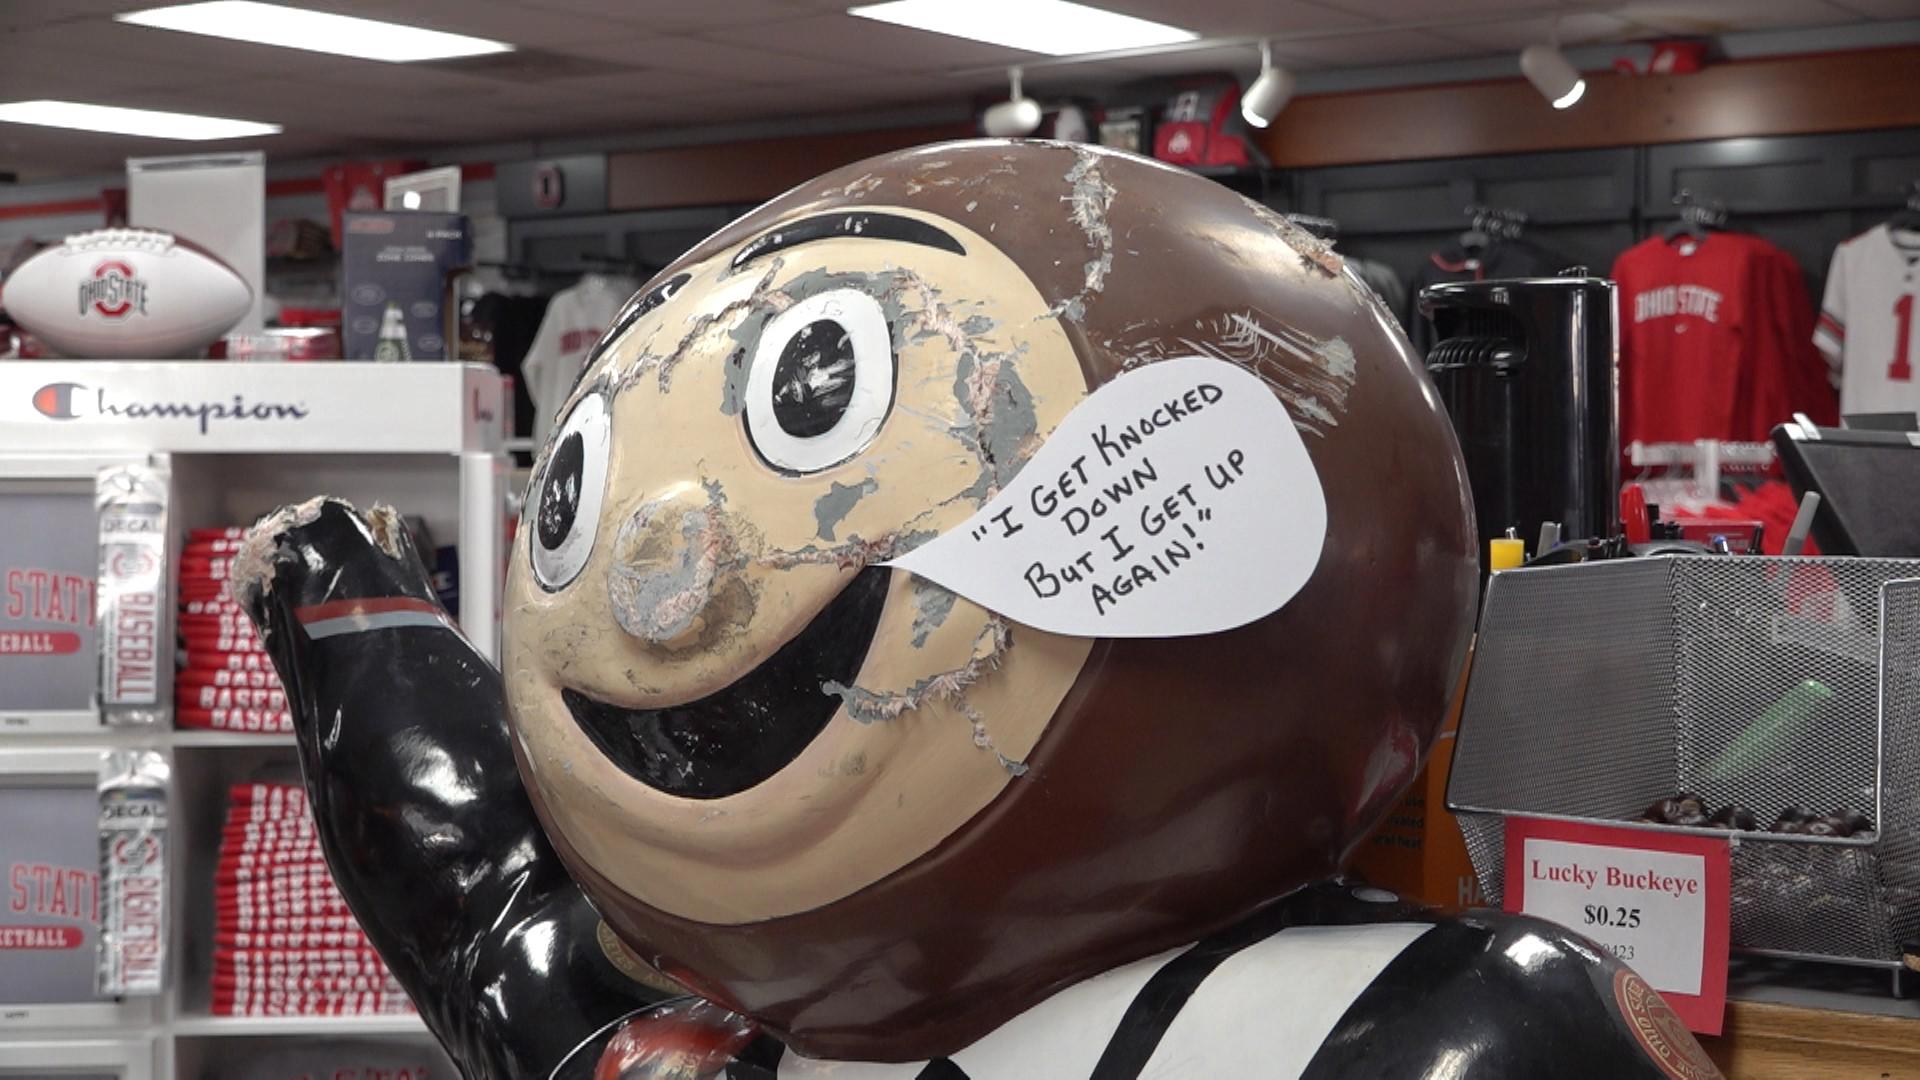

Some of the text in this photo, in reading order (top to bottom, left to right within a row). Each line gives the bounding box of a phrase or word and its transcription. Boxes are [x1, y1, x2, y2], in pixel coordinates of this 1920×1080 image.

[1634, 284, 1724, 323] OHIO STATE
[33, 382, 308, 434] Champion
[1031, 455, 1089, 517] GET
[1092, 384, 1223, 466] KNOCKED
[1061, 457, 1158, 535] DOWN
[1101, 525, 1134, 561] I
[1141, 484, 1198, 537] GET
[1204, 448, 1245, 491] UP
[118, 593, 155, 700] BASEBALL
[104, 804, 165, 819] DECAL
[1532, 859, 1698, 898] Lucky Buckeye
[1584, 903, 1641, 928] $0.25
